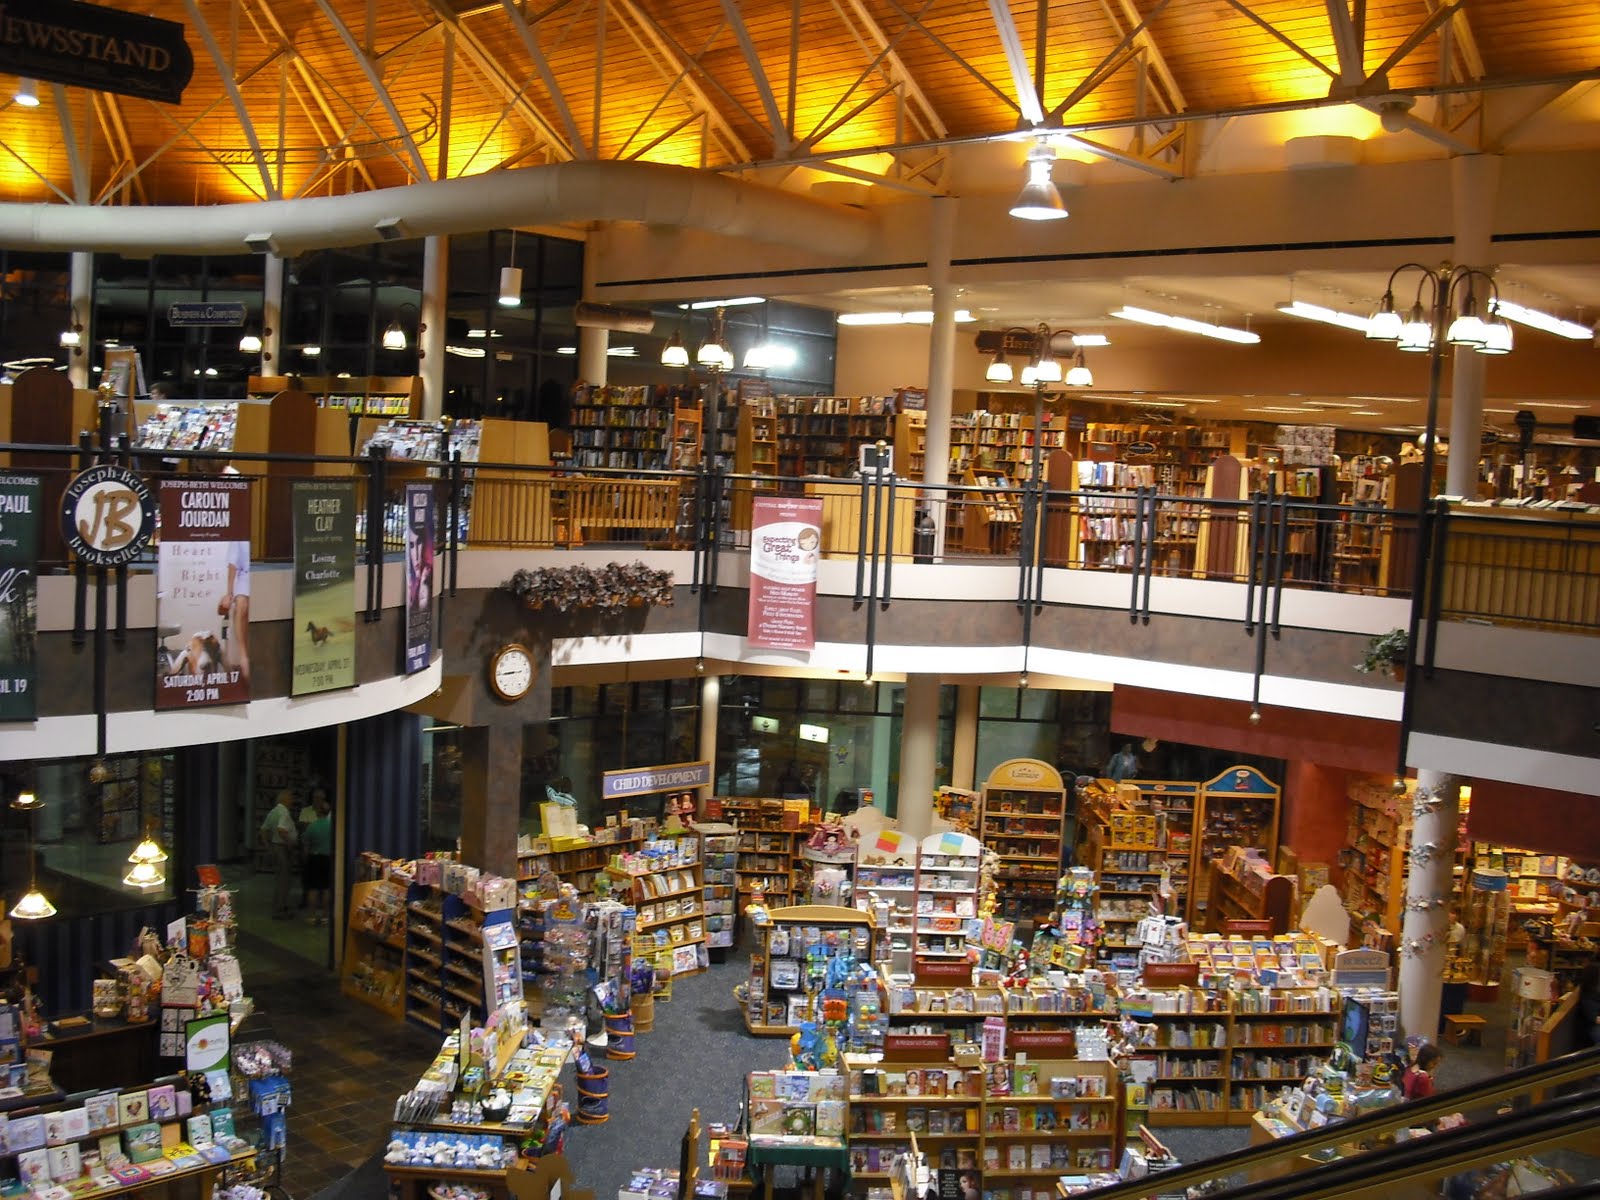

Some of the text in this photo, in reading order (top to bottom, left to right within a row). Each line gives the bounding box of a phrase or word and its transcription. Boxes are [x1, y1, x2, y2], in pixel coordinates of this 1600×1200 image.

[68, 467, 149, 500] Joseph-Beth
[161, 481, 248, 489] JOSEPH-BETH WELCOMES
[0, 495, 32, 514] PAUL
[181, 492, 230, 509] CAROLYN
[307, 498, 341, 514] HEATHER
[79, 490, 140, 549] JB
[179, 510, 230, 528] JOURDAN
[315, 516, 334, 532] CLAY
[762, 536, 796, 546] Expecting
[69, 534, 149, 565] Booksellers
[172, 545, 213, 556] Heart
[763, 543, 792, 554] Great
[311, 553, 336, 563] Losing
[775, 552, 800, 564] Things
[181, 569, 220, 582] Right
[305, 570, 340, 580] Charlotte
[172, 587, 212, 599] Place
[14, 679, 28, 693] 19
[163, 671, 239, 688] SATURDAY, APRIL 17
[186, 688, 219, 702] 2:00 PM
[613, 769, 702, 791] CHILD DEVELOPMENT
